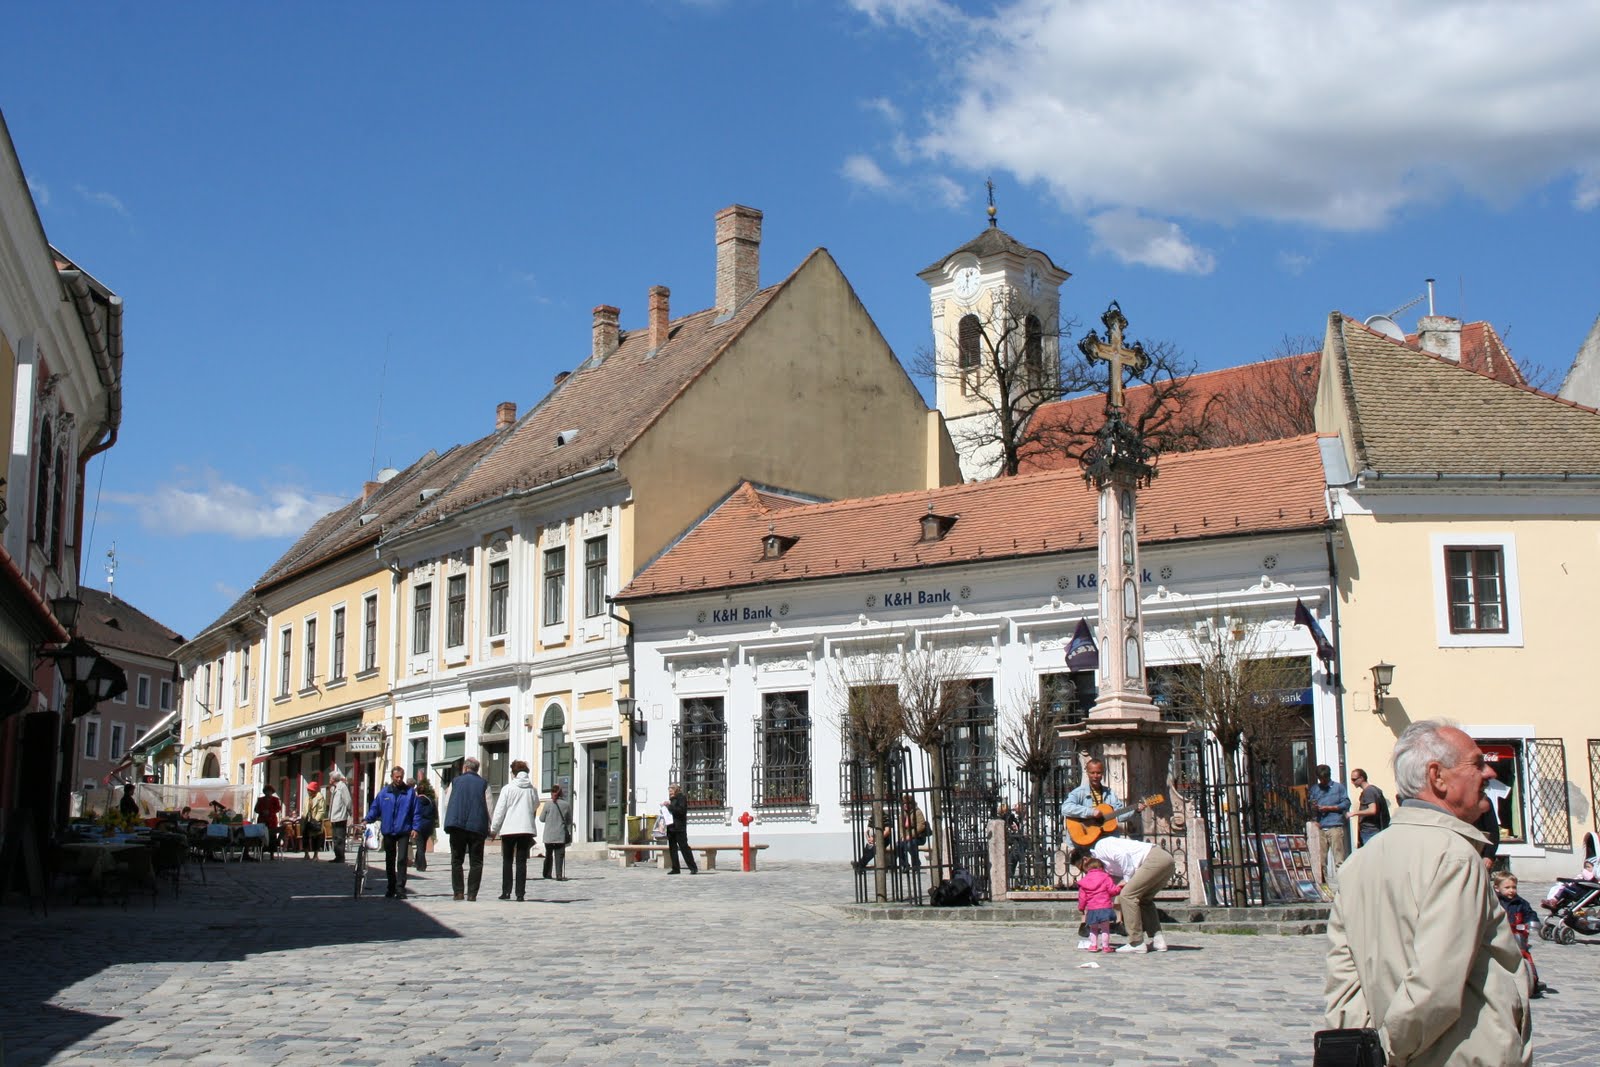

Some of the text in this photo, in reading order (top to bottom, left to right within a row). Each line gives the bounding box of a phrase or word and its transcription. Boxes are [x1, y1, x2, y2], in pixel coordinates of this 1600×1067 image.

[1076, 573, 1097, 588] K&
[884, 588, 951, 607] K&H Bank
[713, 605, 772, 623] K&H Bank
